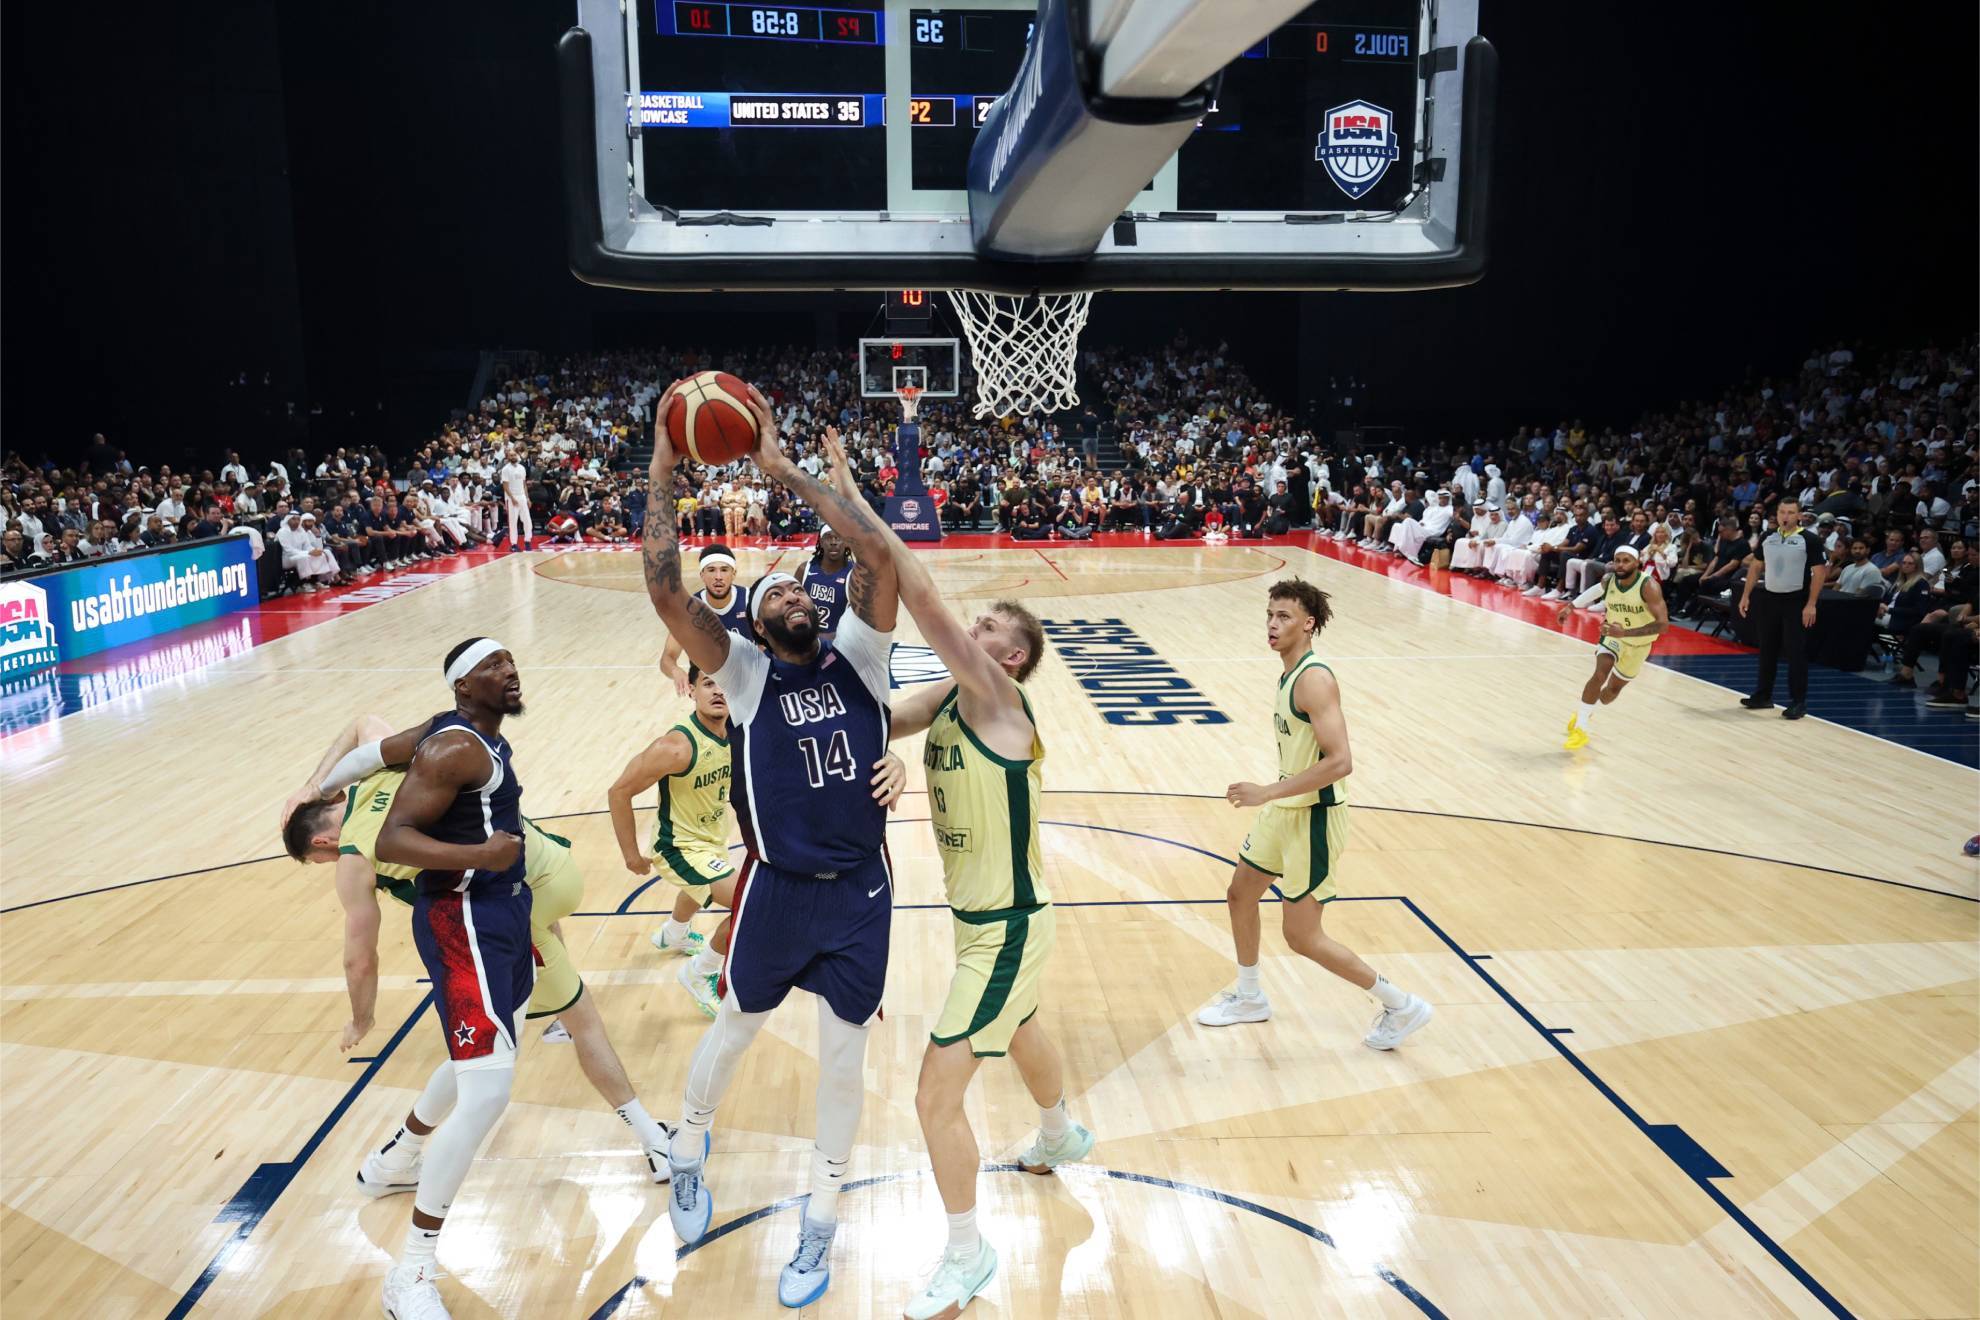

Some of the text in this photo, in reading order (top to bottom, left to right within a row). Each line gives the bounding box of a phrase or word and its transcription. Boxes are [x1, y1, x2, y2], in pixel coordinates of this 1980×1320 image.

[732, 102, 860, 121] UNITED STATES 35
[1333, 115, 1383, 141] USA
[1320, 147, 1393, 156] BASKETBALL
[891, 522, 930, 531] SHOWCASE
[71, 562, 248, 632] usabfoundation.org
[810, 583, 836, 603] USA
[1624, 617, 1632, 627] 5
[779, 682, 847, 727] USA
[798, 729, 857, 789] 14
[693, 765, 731, 789] AUSTR
[370, 790, 391, 812] KAY
